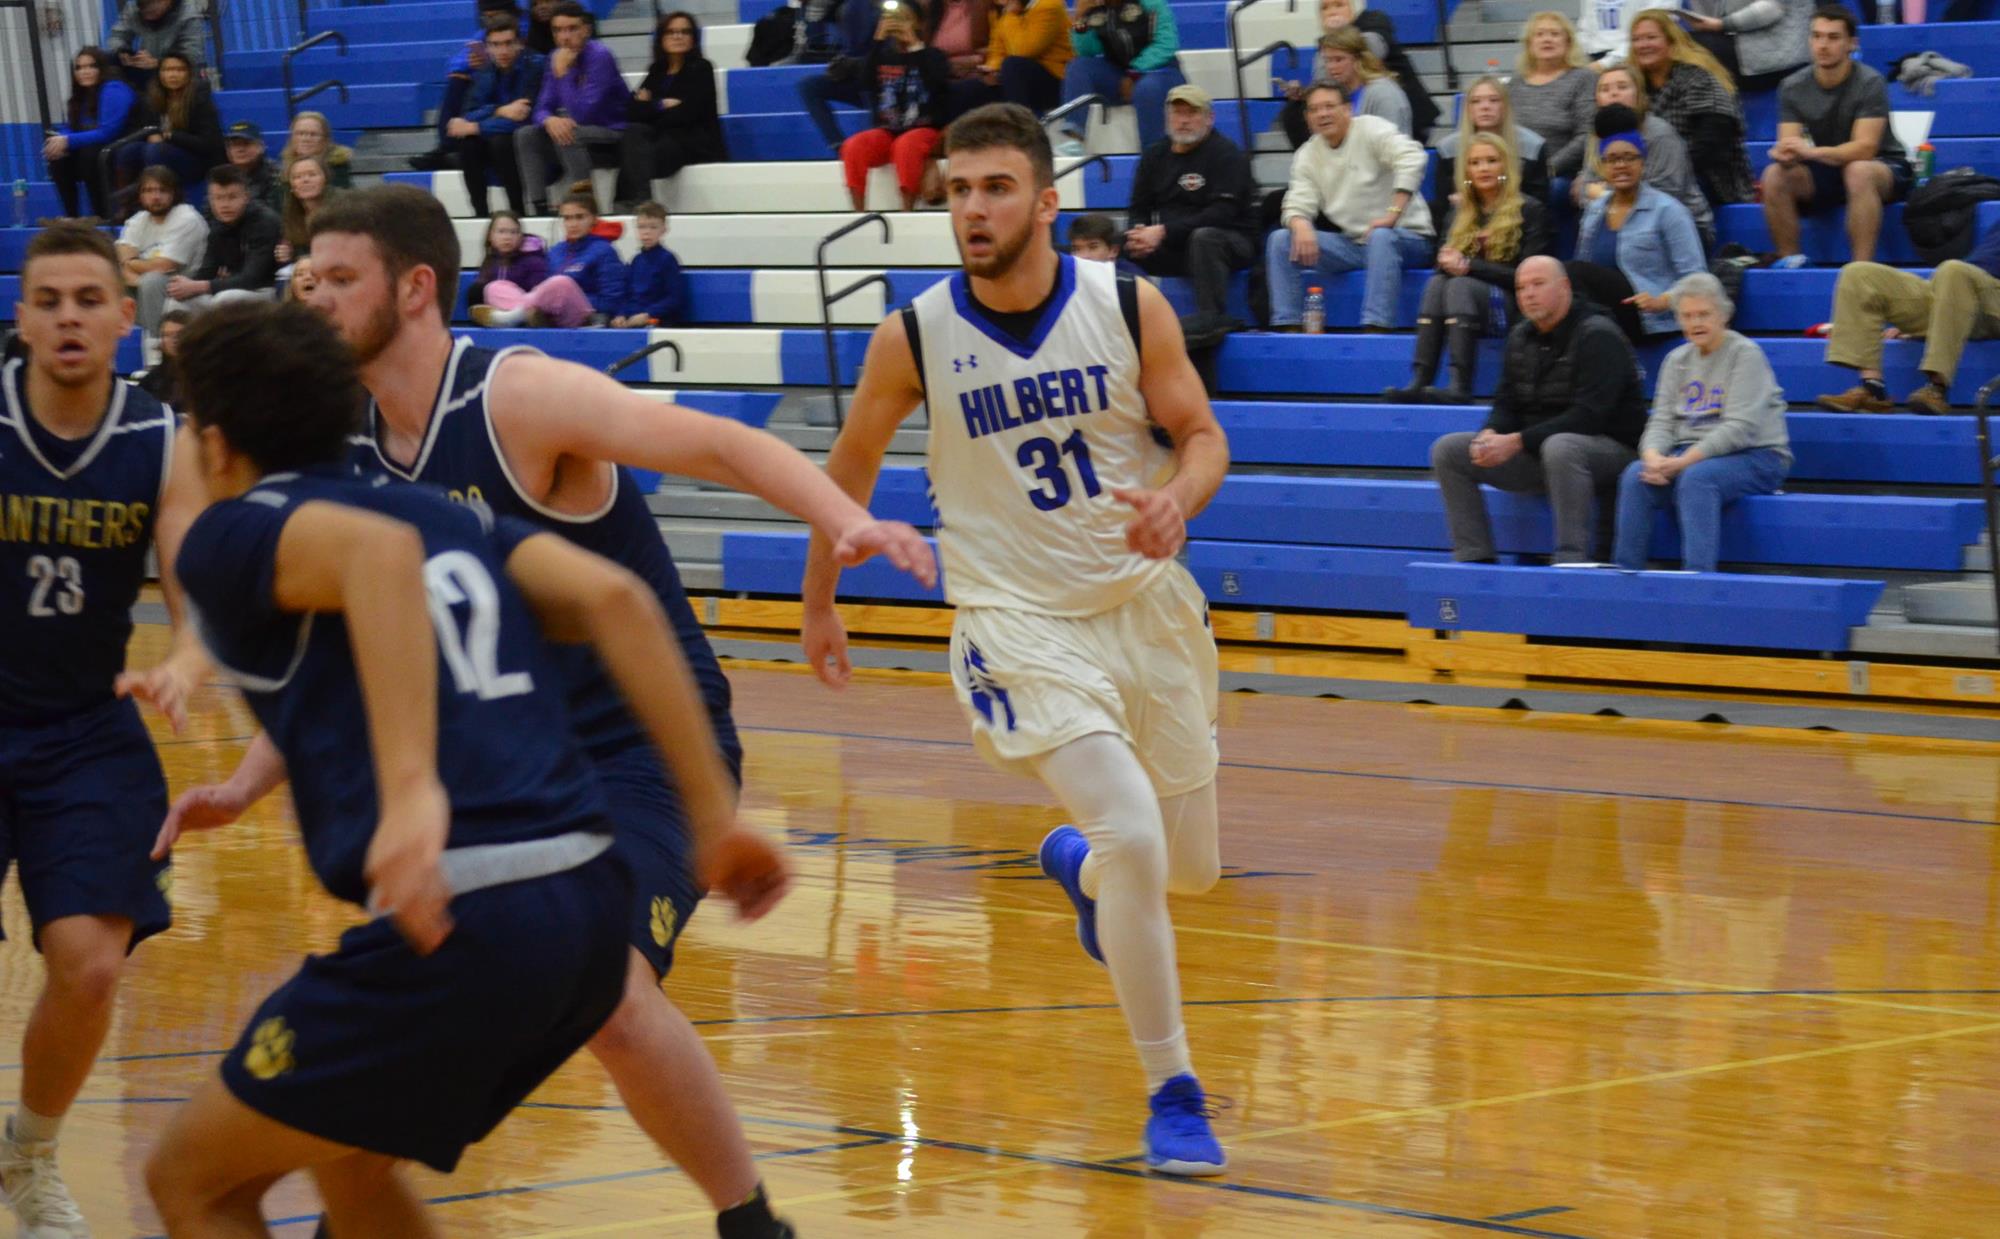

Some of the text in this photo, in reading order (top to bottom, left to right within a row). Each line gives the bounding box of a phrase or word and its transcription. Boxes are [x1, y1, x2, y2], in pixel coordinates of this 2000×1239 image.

[959, 365, 1109, 439] HILBERT
[1016, 428, 1102, 511] 31
[26, 555, 84, 616] 23
